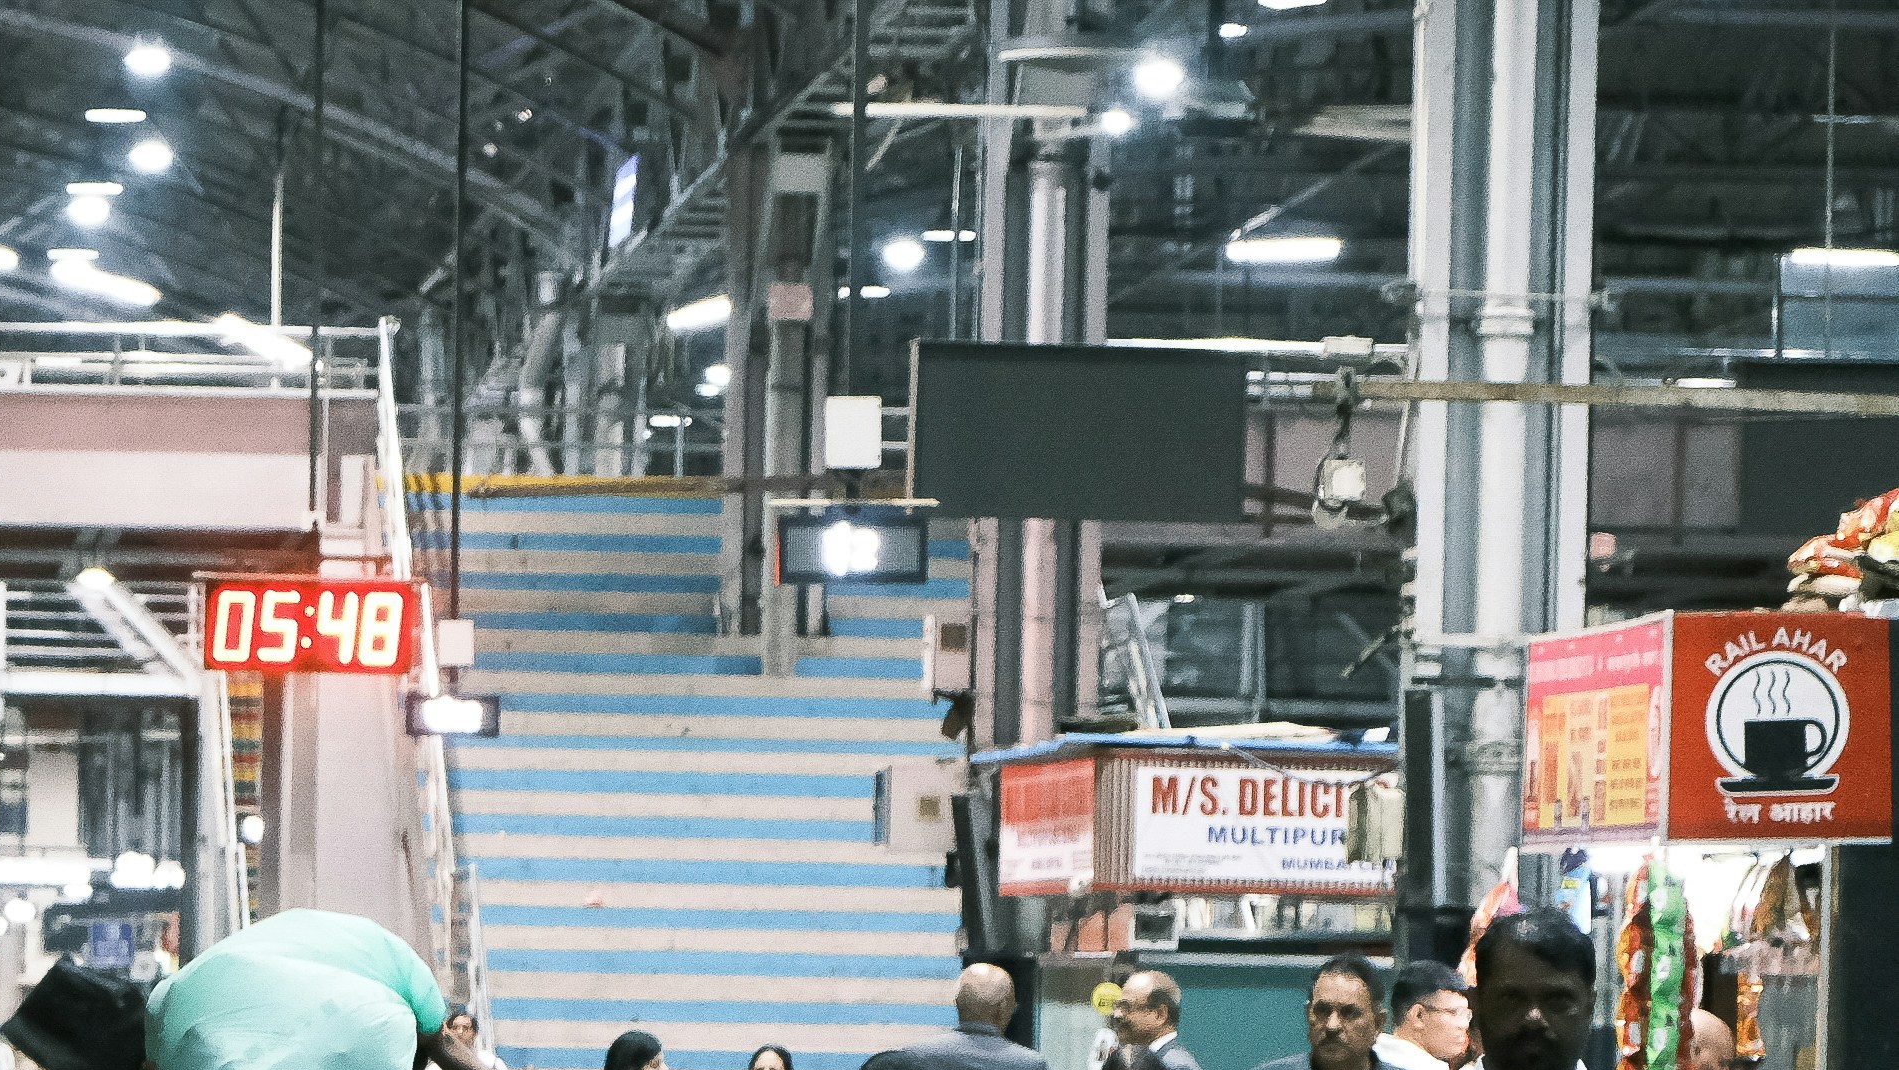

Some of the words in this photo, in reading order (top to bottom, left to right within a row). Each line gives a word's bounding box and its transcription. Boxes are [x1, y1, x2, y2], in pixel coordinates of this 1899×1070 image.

[212, 589, 404, 667] 05:48
[1704, 630, 1767, 678] RAIL
[1771, 626, 1848, 675] AHAR
[1151, 775, 1228, 817] M/S.
[1238, 777, 1390, 818] DELICI
[1768, 801, 1837, 824] आहार
[1281, 857, 1352, 871] MUMBA
